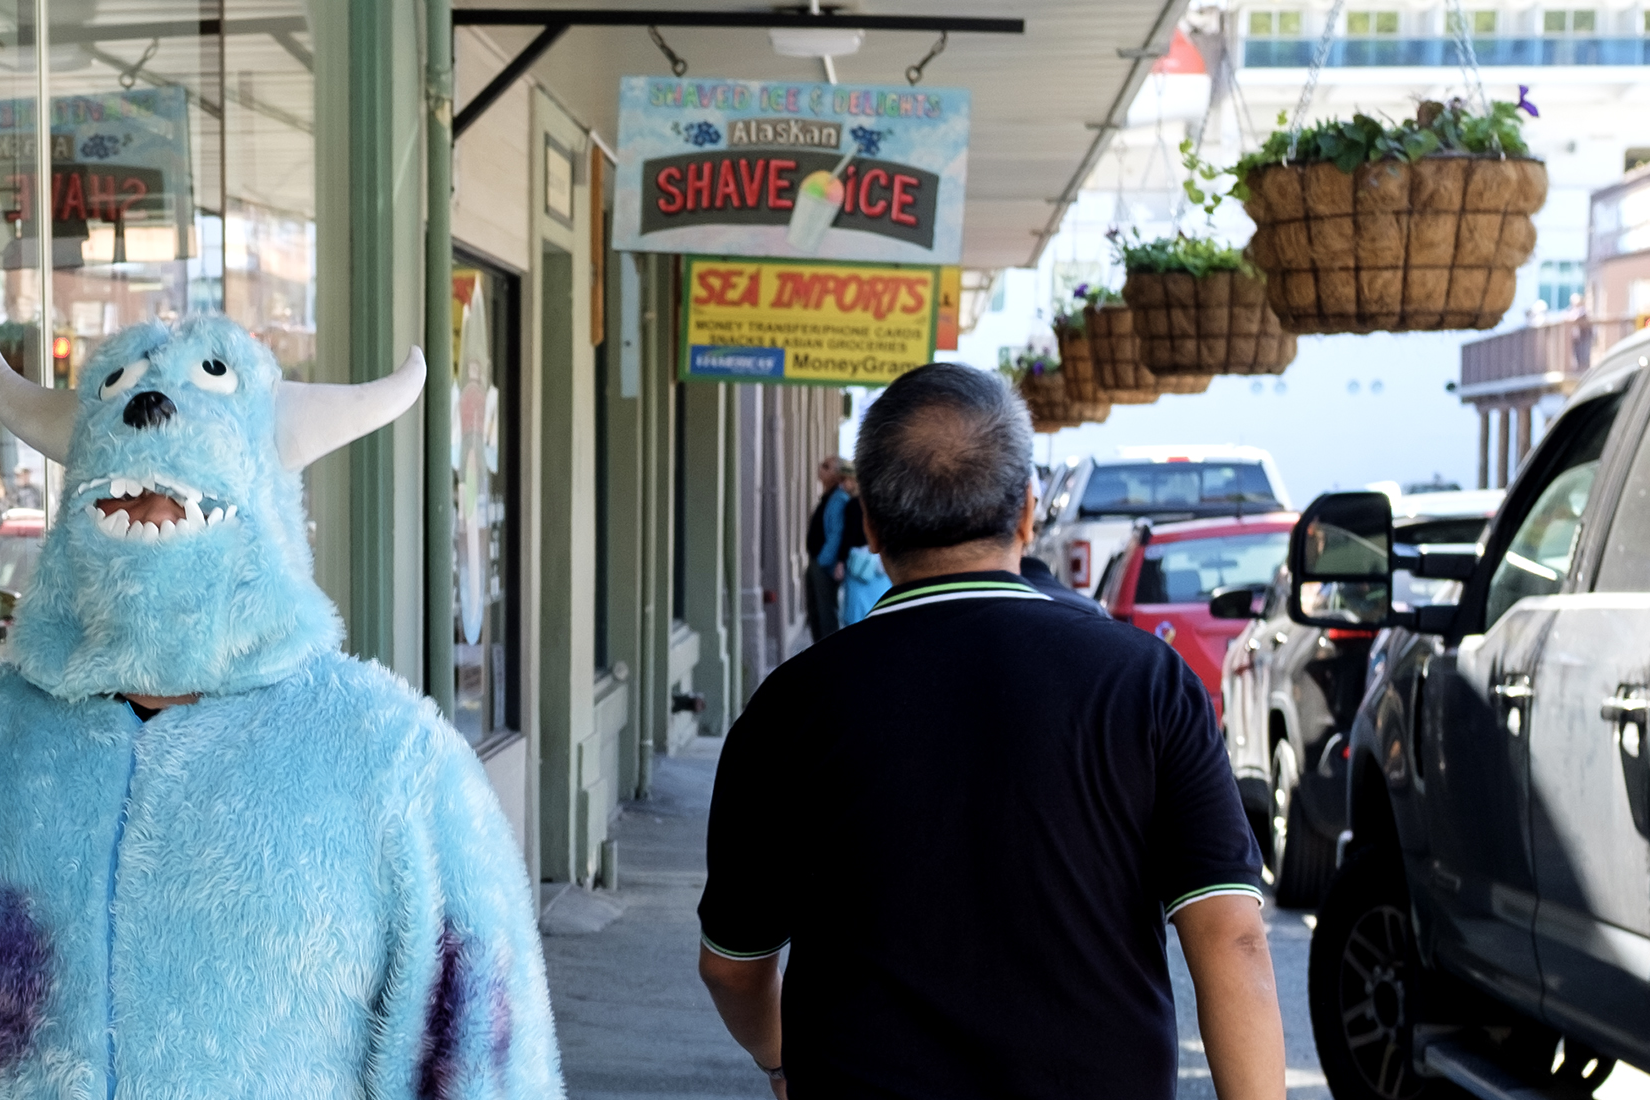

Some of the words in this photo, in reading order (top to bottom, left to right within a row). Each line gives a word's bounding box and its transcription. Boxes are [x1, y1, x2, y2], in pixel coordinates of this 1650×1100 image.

[649, 82, 752, 111] SHAVED
[760, 87, 800, 113] ICE
[832, 89, 941, 119] DELIGHTS
[656, 158, 798, 214] SHAVE
[692, 268, 761, 308] SEA
[770, 271, 929, 321] IMPORTS
[826, 338, 908, 353] GROCERIES
